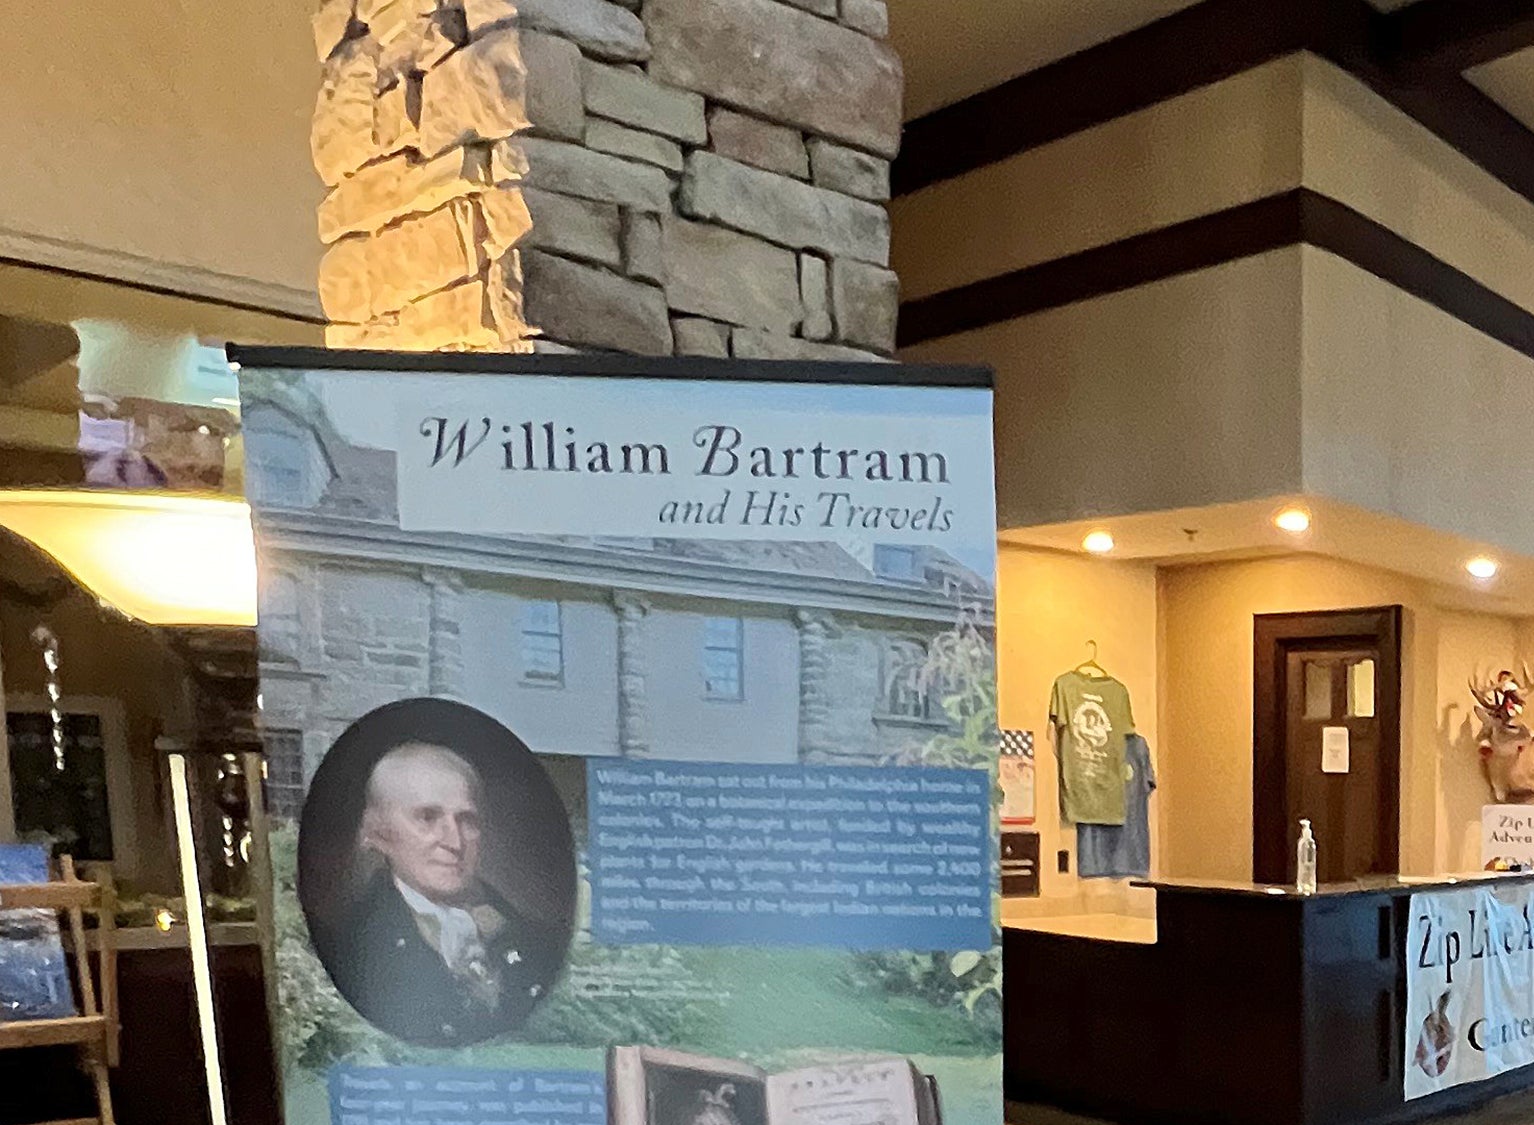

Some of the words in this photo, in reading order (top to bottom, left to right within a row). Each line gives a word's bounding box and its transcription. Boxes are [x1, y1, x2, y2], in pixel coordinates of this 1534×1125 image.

[419, 416, 672, 475] William
[692, 424, 952, 485] Bartram
[657, 490, 732, 526] and
[740, 491, 802, 528] His
[816, 492, 954, 532] Travels
[1499, 815, 1523, 831] Zip
[1419, 915, 1460, 983] Zip
